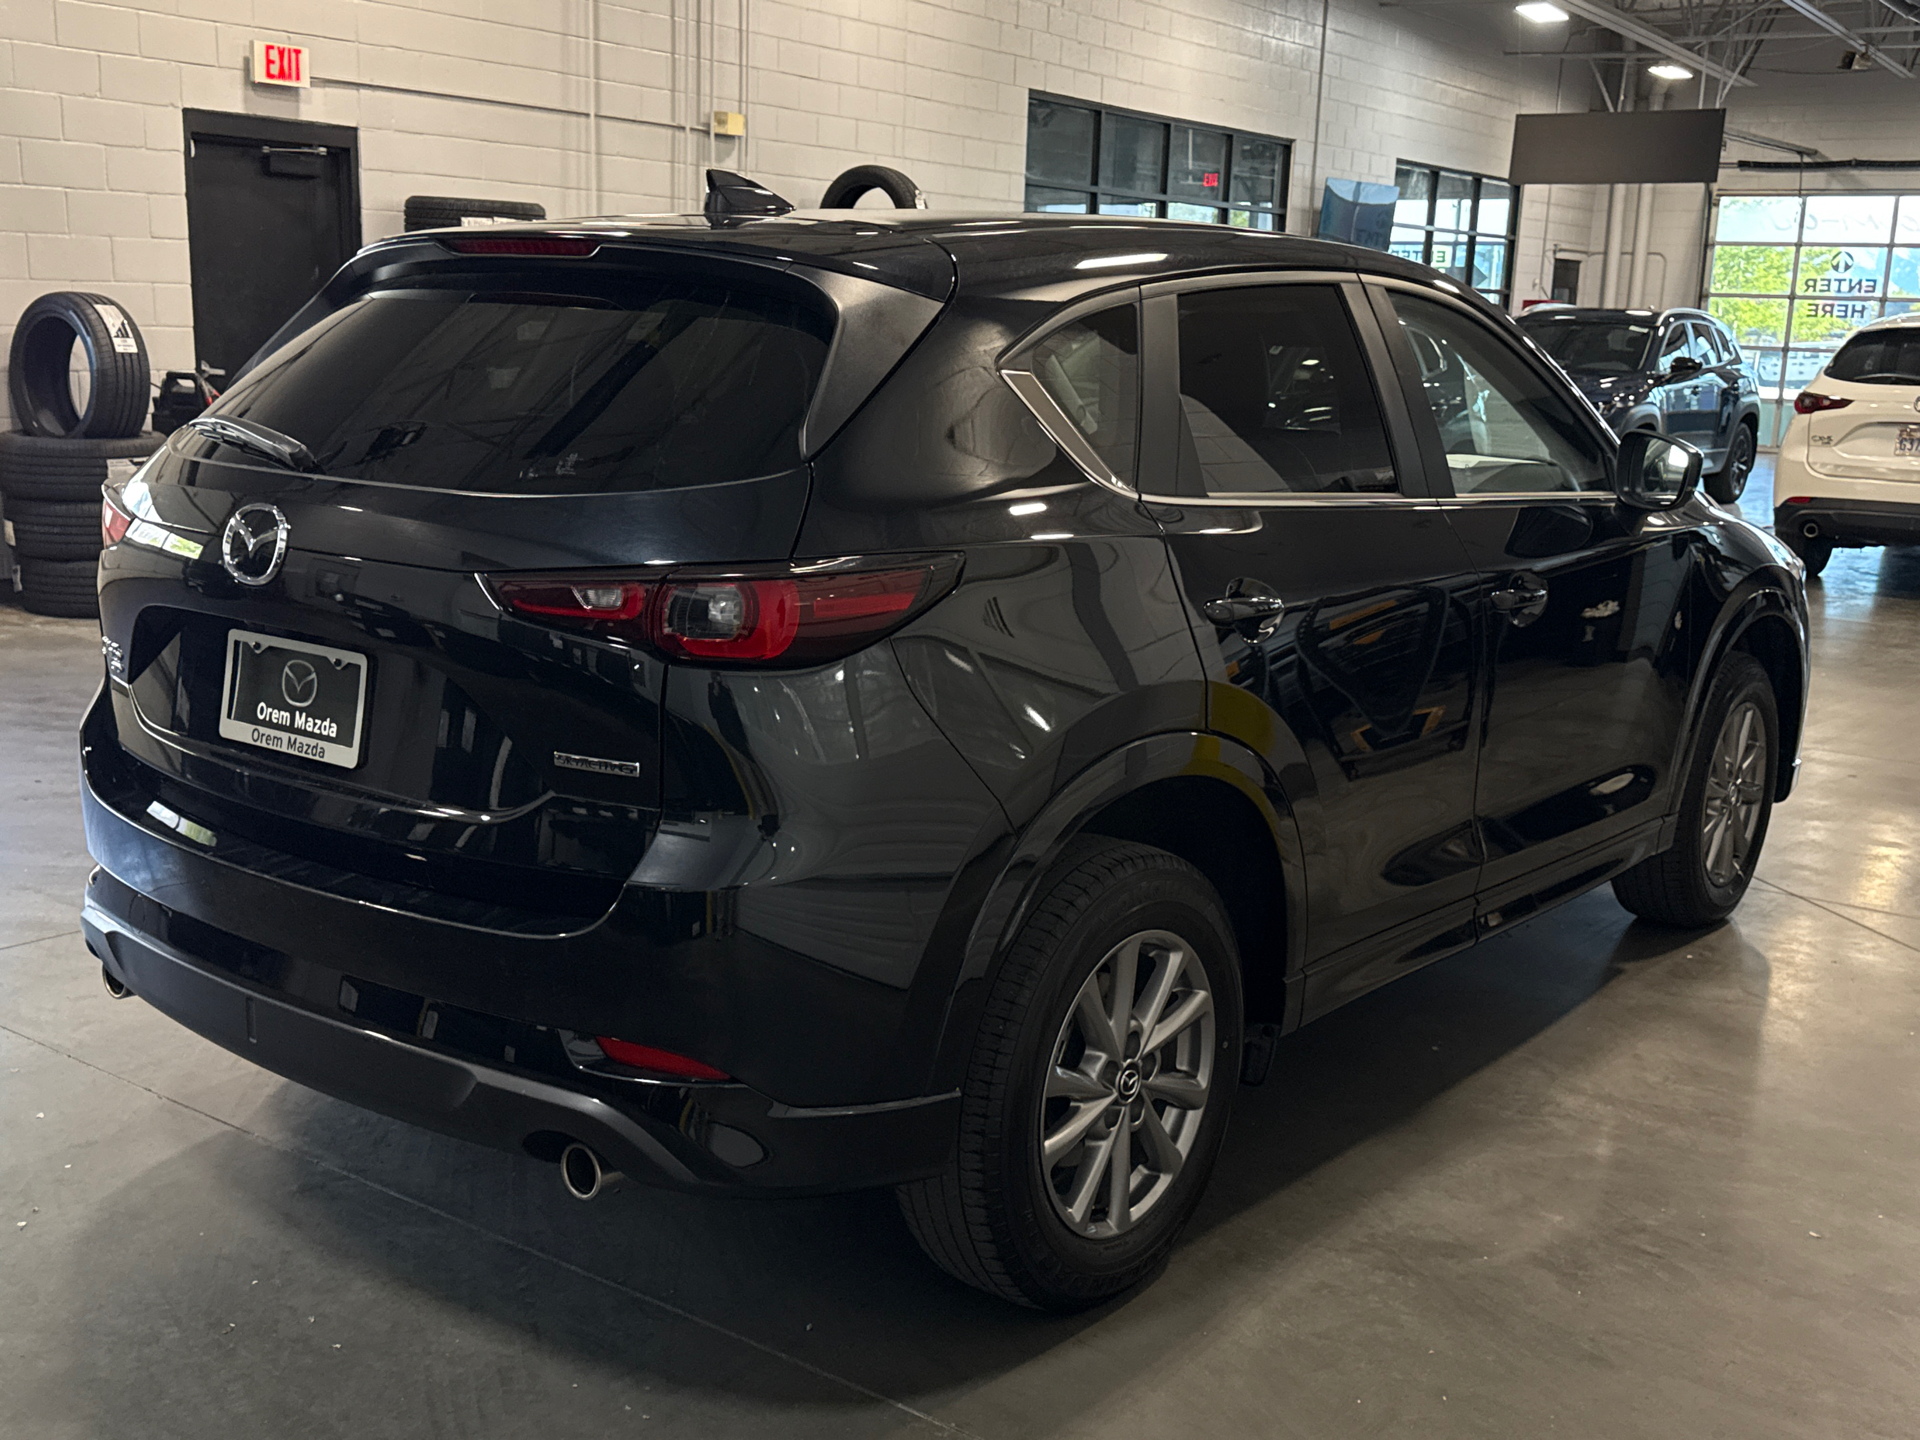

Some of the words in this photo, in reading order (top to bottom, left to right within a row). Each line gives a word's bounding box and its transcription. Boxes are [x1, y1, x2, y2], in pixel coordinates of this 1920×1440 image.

[265, 44, 302, 82] EXIT
[256, 702, 291, 727] Orem
[294, 710, 338, 738] Mazda
[251, 728, 283, 749] Orem
[286, 739, 326, 759] Mazda
